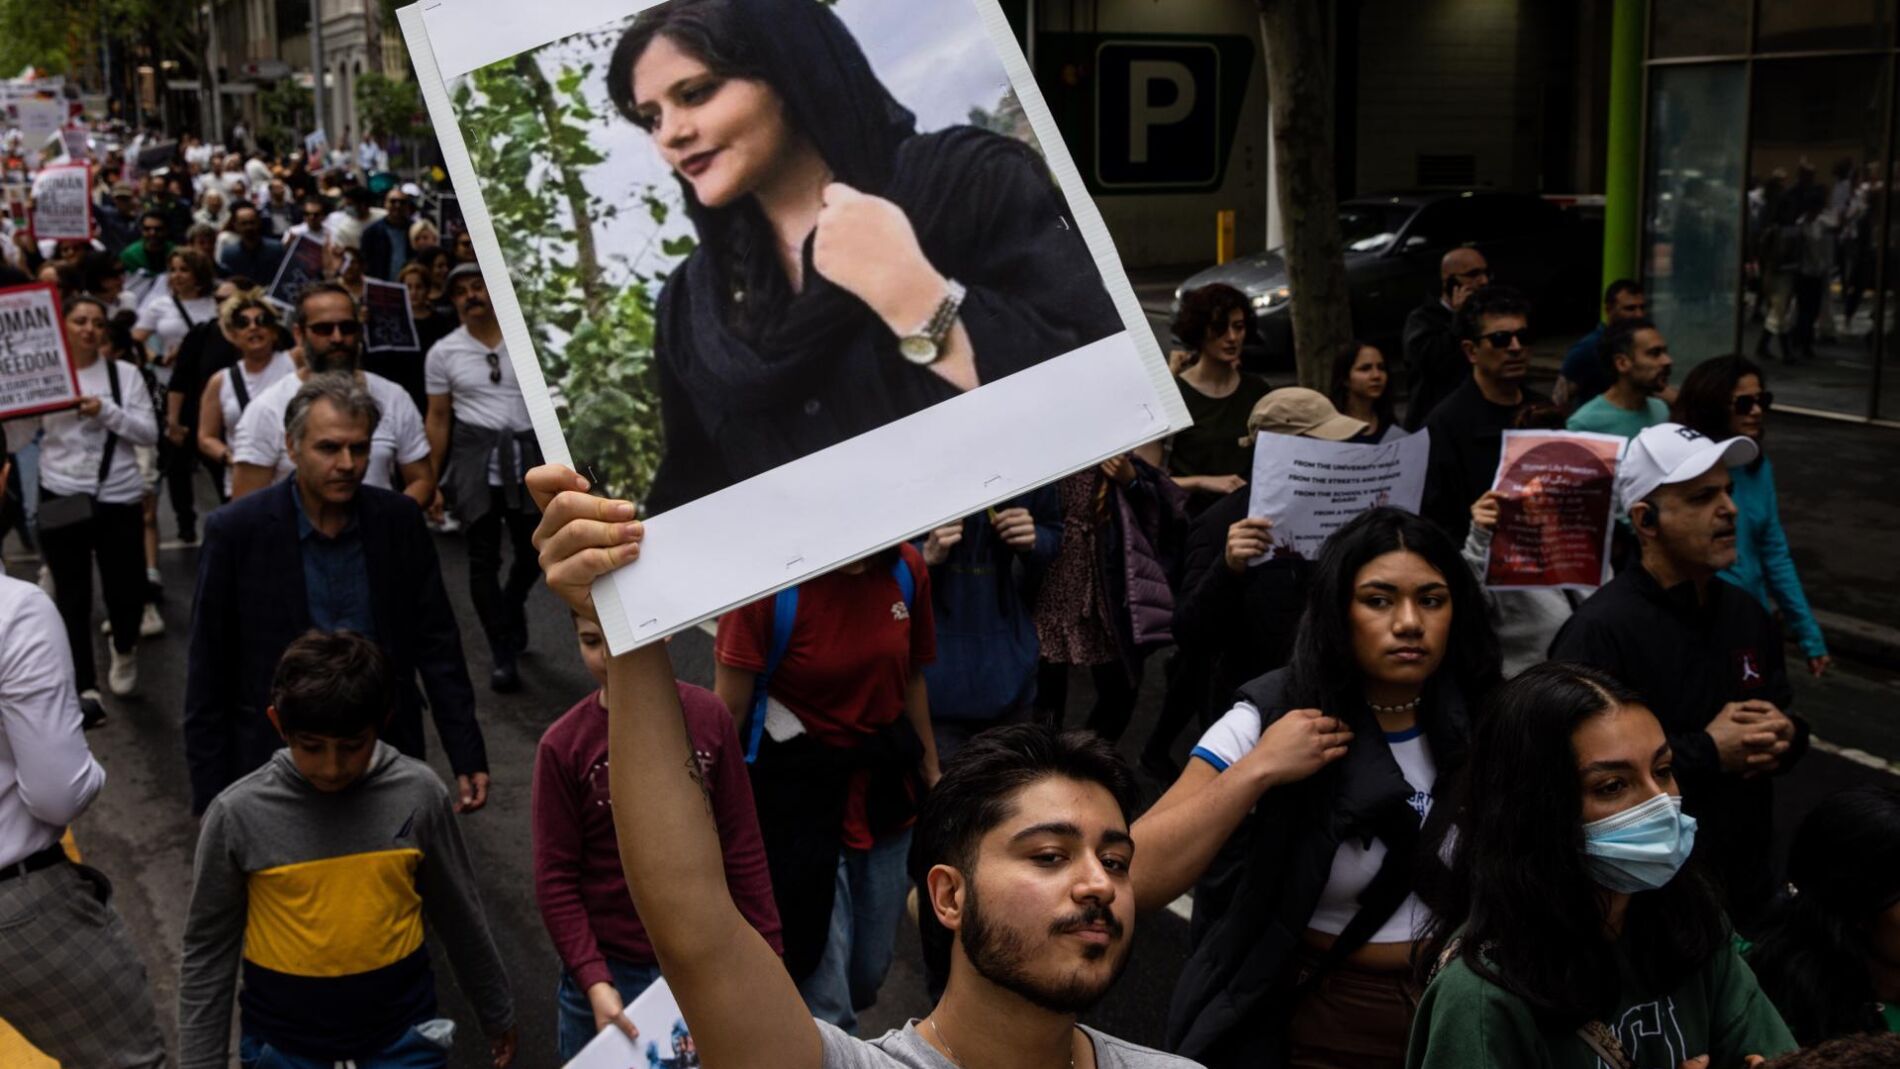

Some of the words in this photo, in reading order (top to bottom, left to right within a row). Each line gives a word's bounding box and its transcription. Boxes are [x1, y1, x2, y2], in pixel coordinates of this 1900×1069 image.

[1129, 60, 1195, 163] P
[1294, 460, 1315, 468] FROM
[1317, 462, 1331, 470] THE
[1288, 474, 1310, 482] FROM
[1331, 496, 1357, 504] BOARD
